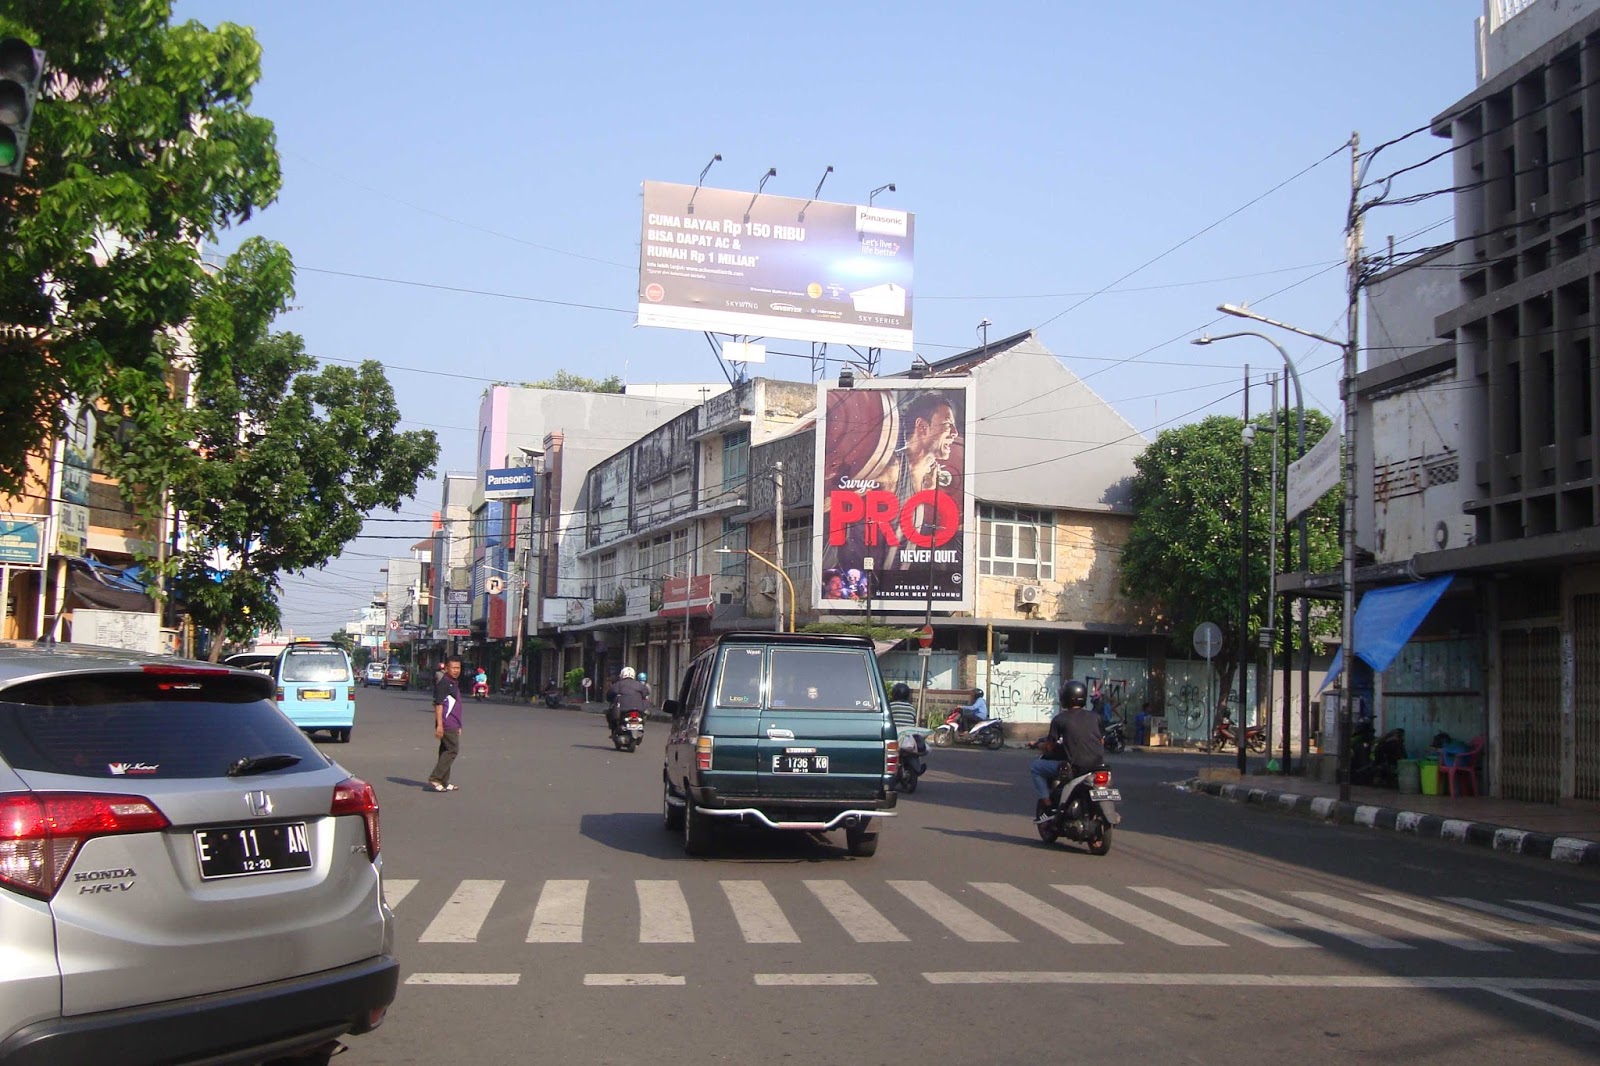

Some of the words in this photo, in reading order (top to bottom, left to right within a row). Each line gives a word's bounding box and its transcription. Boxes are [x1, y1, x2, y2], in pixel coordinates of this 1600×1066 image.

[861, 212, 902, 225] Panasonic
[648, 213, 681, 228] CUMA
[683, 217, 720, 232] BAYAR
[723, 219, 742, 237] Rp
[745, 221, 771, 239] 150
[774, 225, 806, 242] RIBU
[647, 229, 674, 243] BISA
[676, 232, 714, 247] DAPAT
[714, 236, 730, 249] AC
[732, 239, 742, 250] &
[862, 238, 878, 247] Let's
[879, 240, 892, 248] live
[646, 246, 688, 260] RUMAH
[690, 250, 706, 264] Rp
[708, 252, 714, 263] 1
[874, 247, 897, 256] better
[725, 300, 758, 310] SKYWING
[875, 317, 900, 326] SERIES
[488, 473, 532, 486] Panasonic
[838, 476, 880, 493] Surya
[828, 490, 959, 548] PRO
[934, 550, 958, 564] QUIT.
[774, 756, 780, 768] E
[788, 757, 808, 768] 1736
[196, 832, 211, 861] E
[240, 829, 260, 858] 11
[288, 825, 308, 854] AN
[74, 868, 136, 882] HONDA
[79, 882, 135, 895] HR-V
